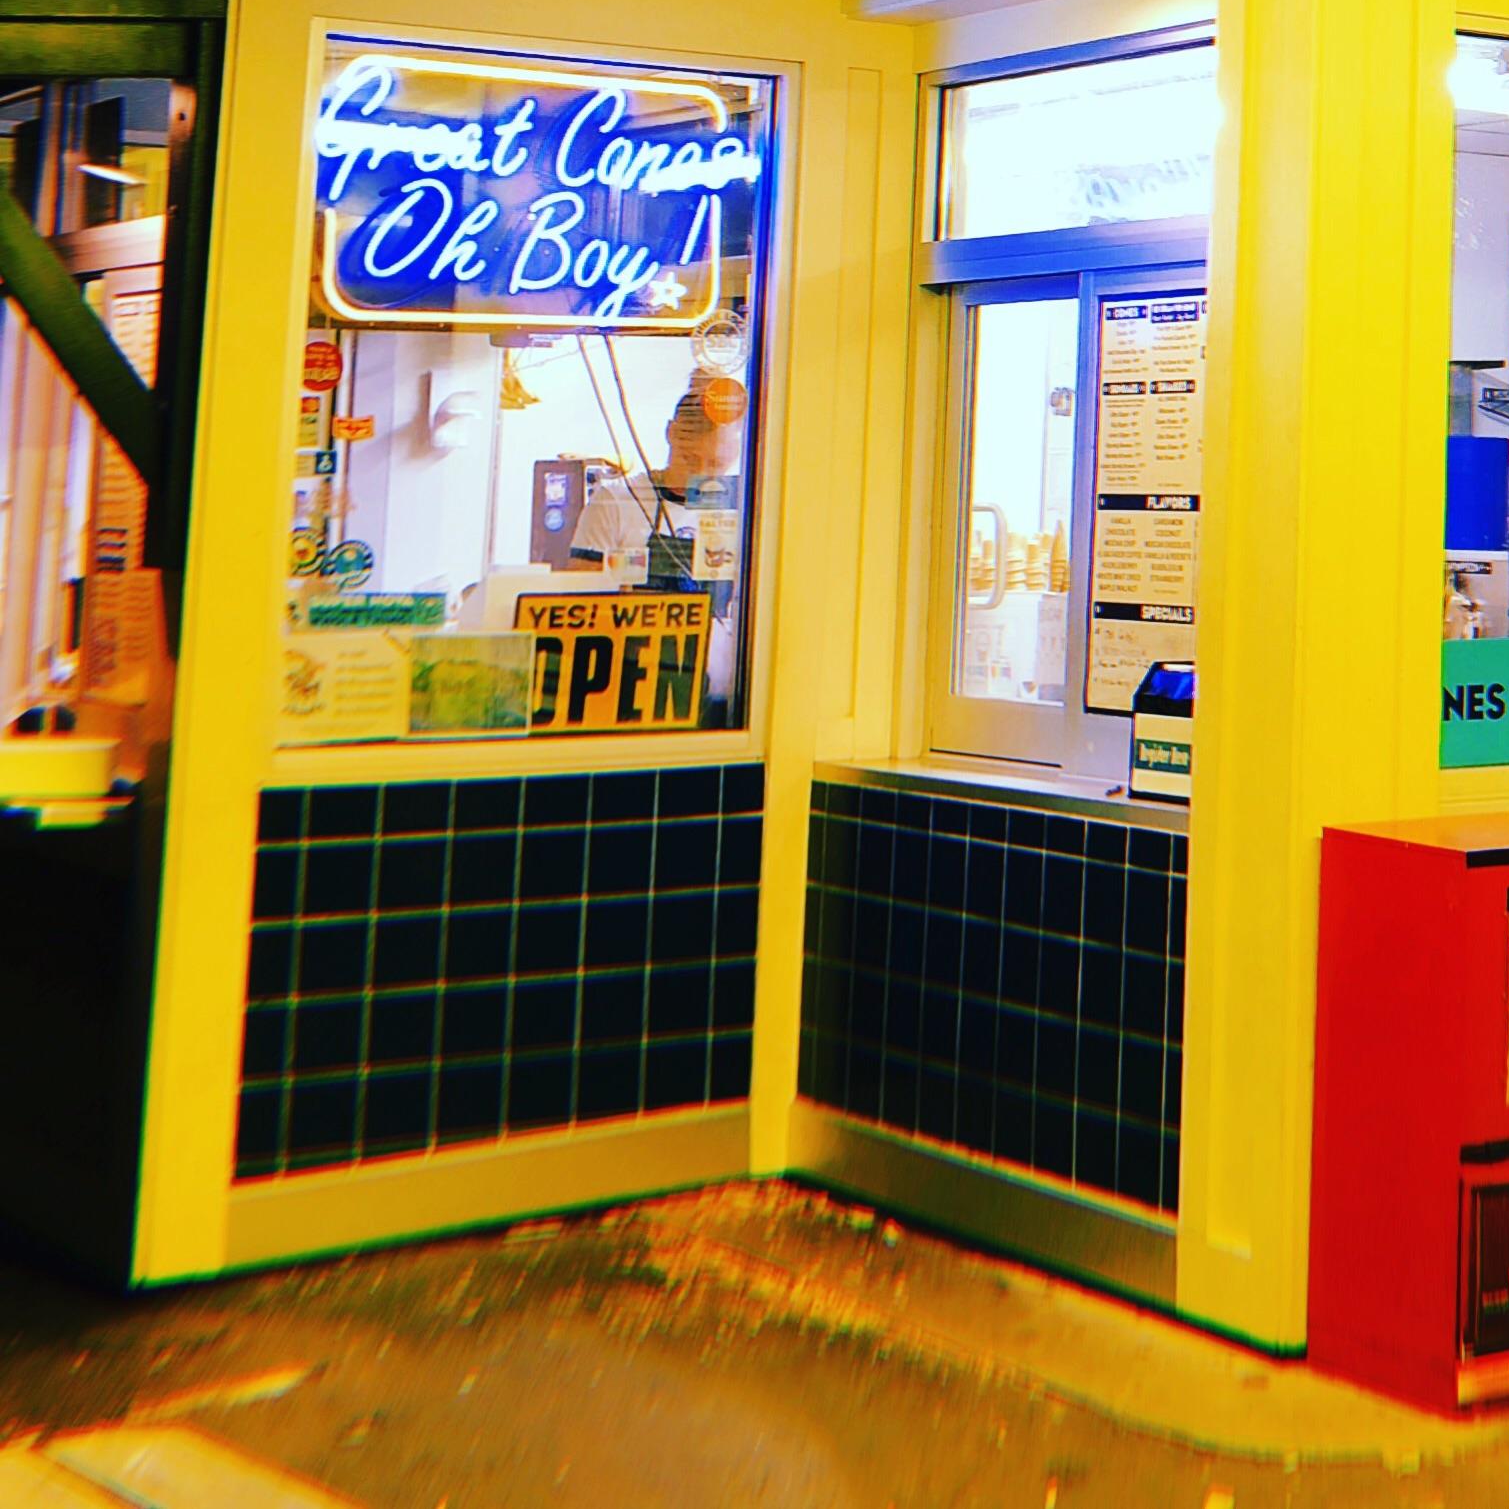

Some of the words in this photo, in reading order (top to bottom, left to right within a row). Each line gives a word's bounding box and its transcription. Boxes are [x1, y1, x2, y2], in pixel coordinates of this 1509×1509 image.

[364, 179, 500, 283] Oh
[1145, 495, 1192, 510] FLAVORS
[529, 604, 599, 629] YES!
[611, 601, 704, 629] WE'RE
[1142, 605, 1192, 623] SPECIALS
[531, 633, 700, 728] OPEN
